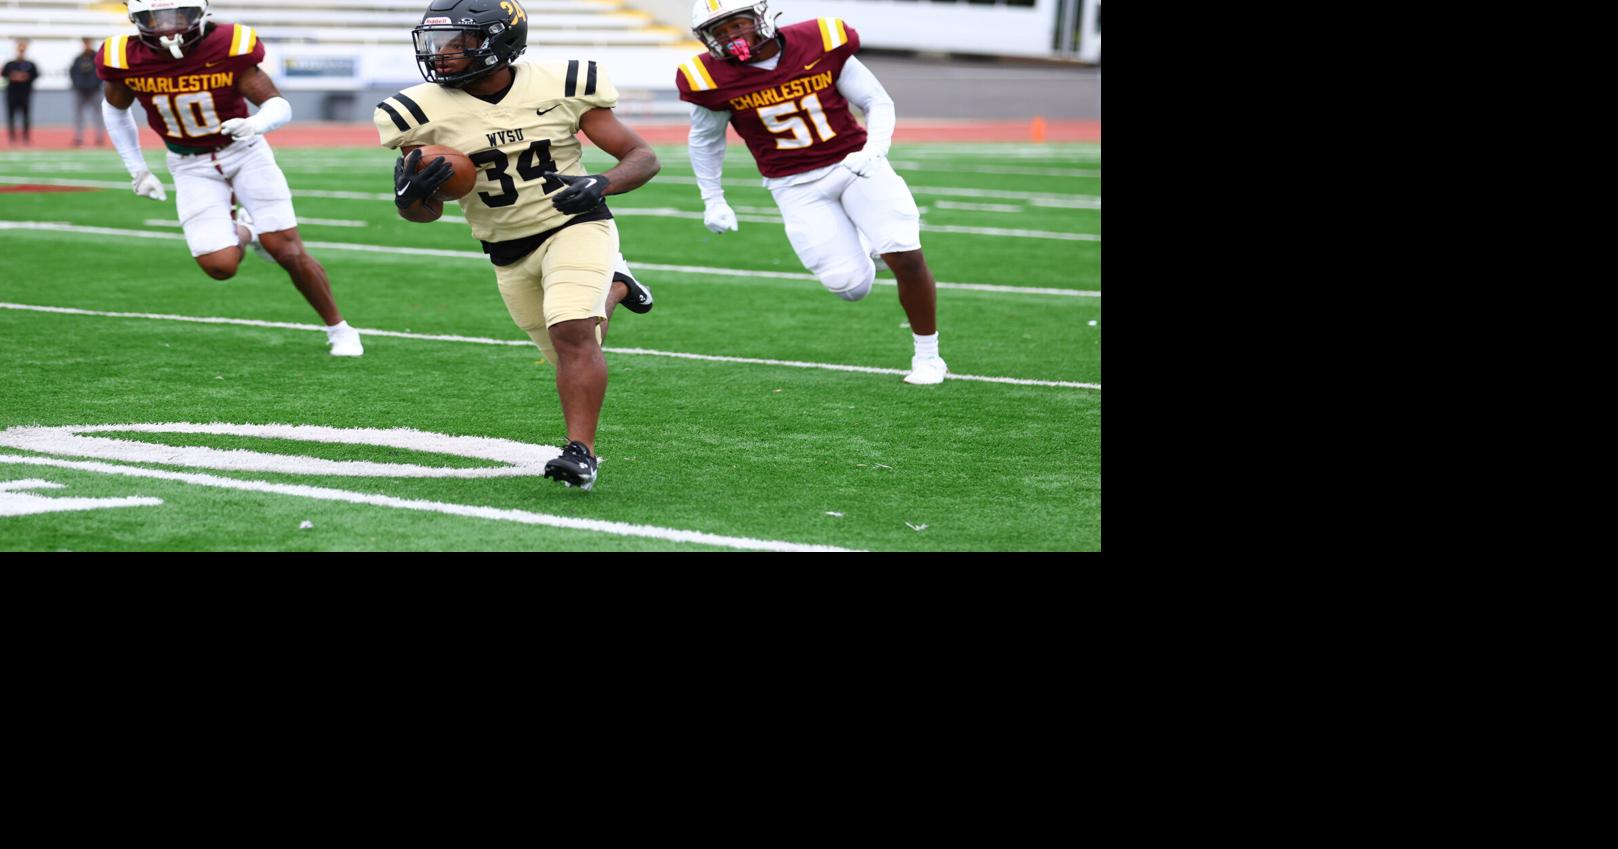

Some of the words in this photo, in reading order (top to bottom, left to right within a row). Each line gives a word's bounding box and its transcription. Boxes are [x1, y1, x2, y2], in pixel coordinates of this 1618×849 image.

[124, 71, 233, 93] CHARLESTON
[729, 69, 832, 110] CHARLESTON
[151, 91, 221, 138] 10
[756, 92, 837, 150] 51
[486, 128, 524, 147] WVSU
[469, 139, 565, 208] 34
